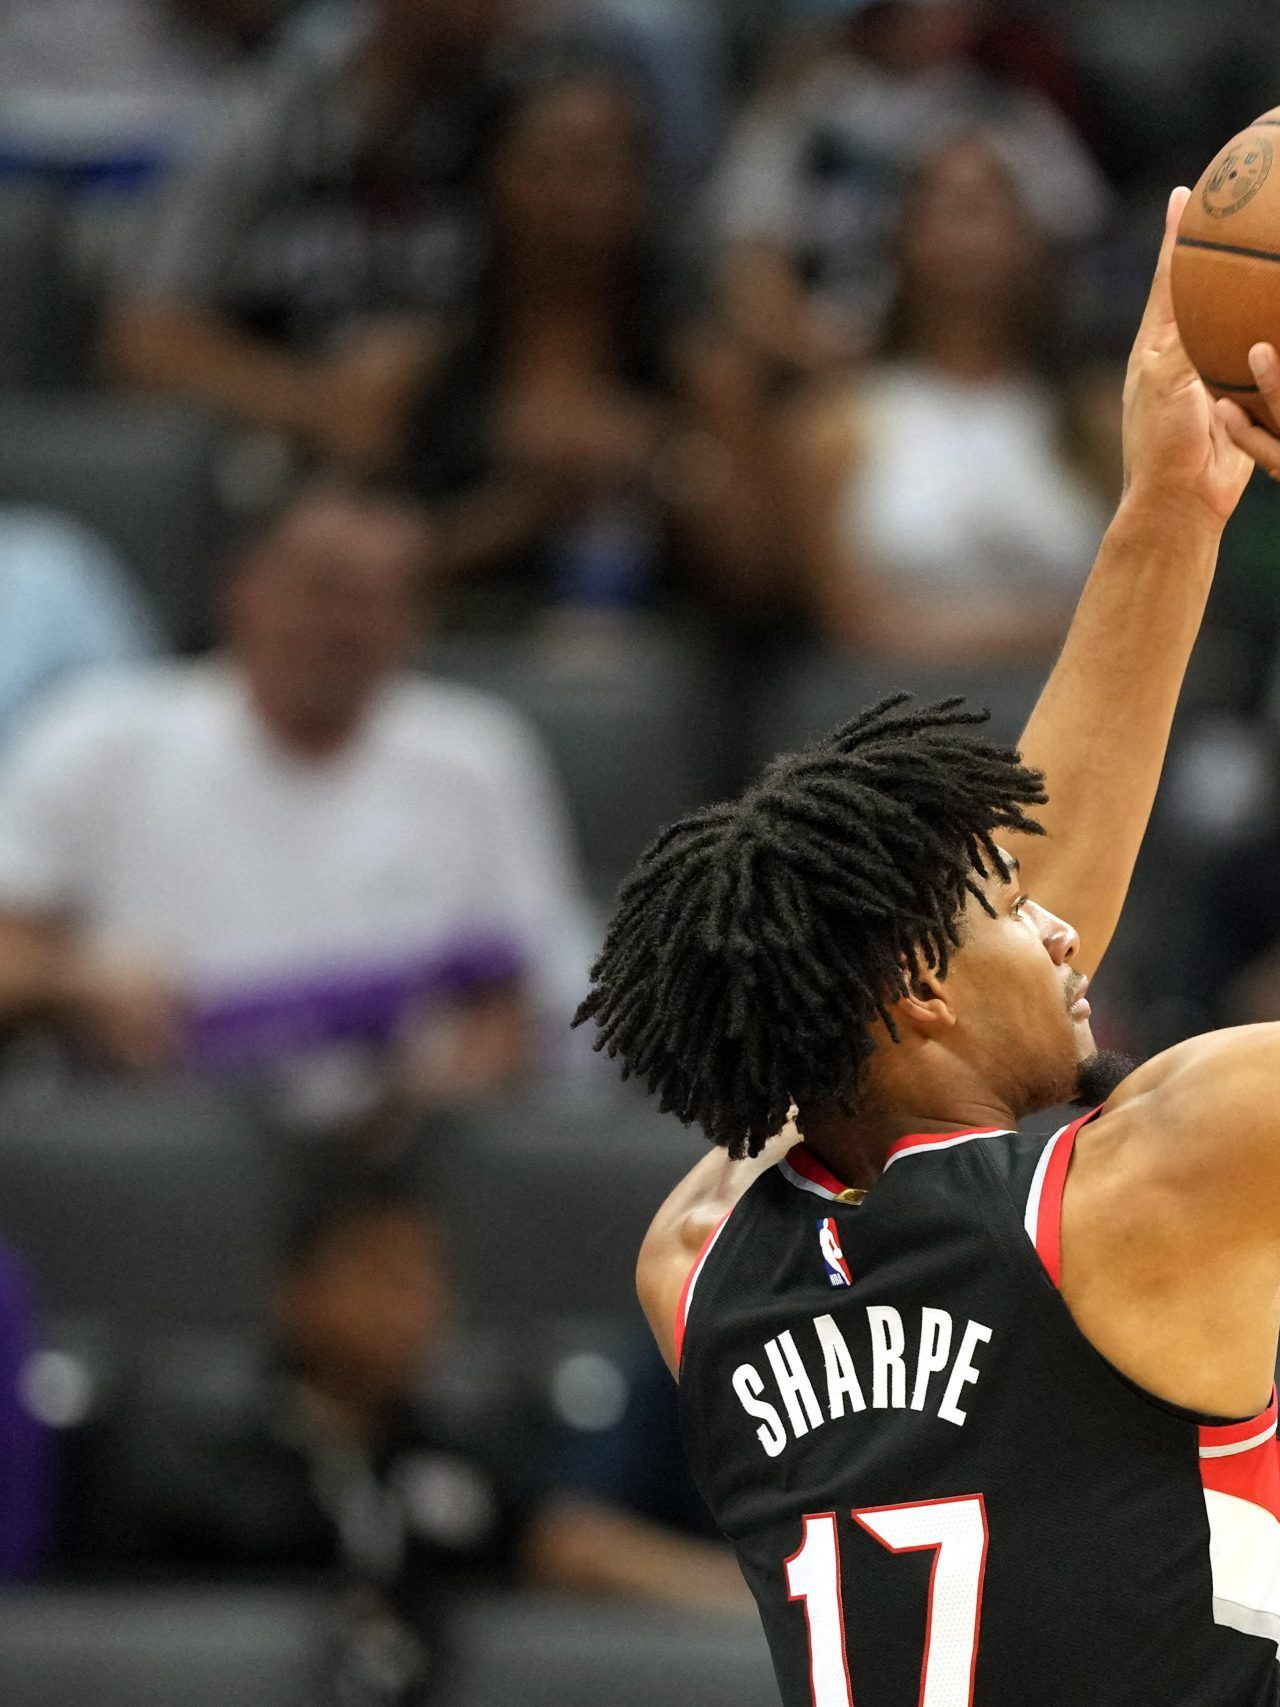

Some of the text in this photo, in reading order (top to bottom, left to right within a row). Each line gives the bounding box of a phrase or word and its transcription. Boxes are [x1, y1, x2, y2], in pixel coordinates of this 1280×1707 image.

[830, 1273, 844, 1286] NBA
[732, 1306, 993, 1457] SHARPE
[784, 1493, 988, 1707] 17
